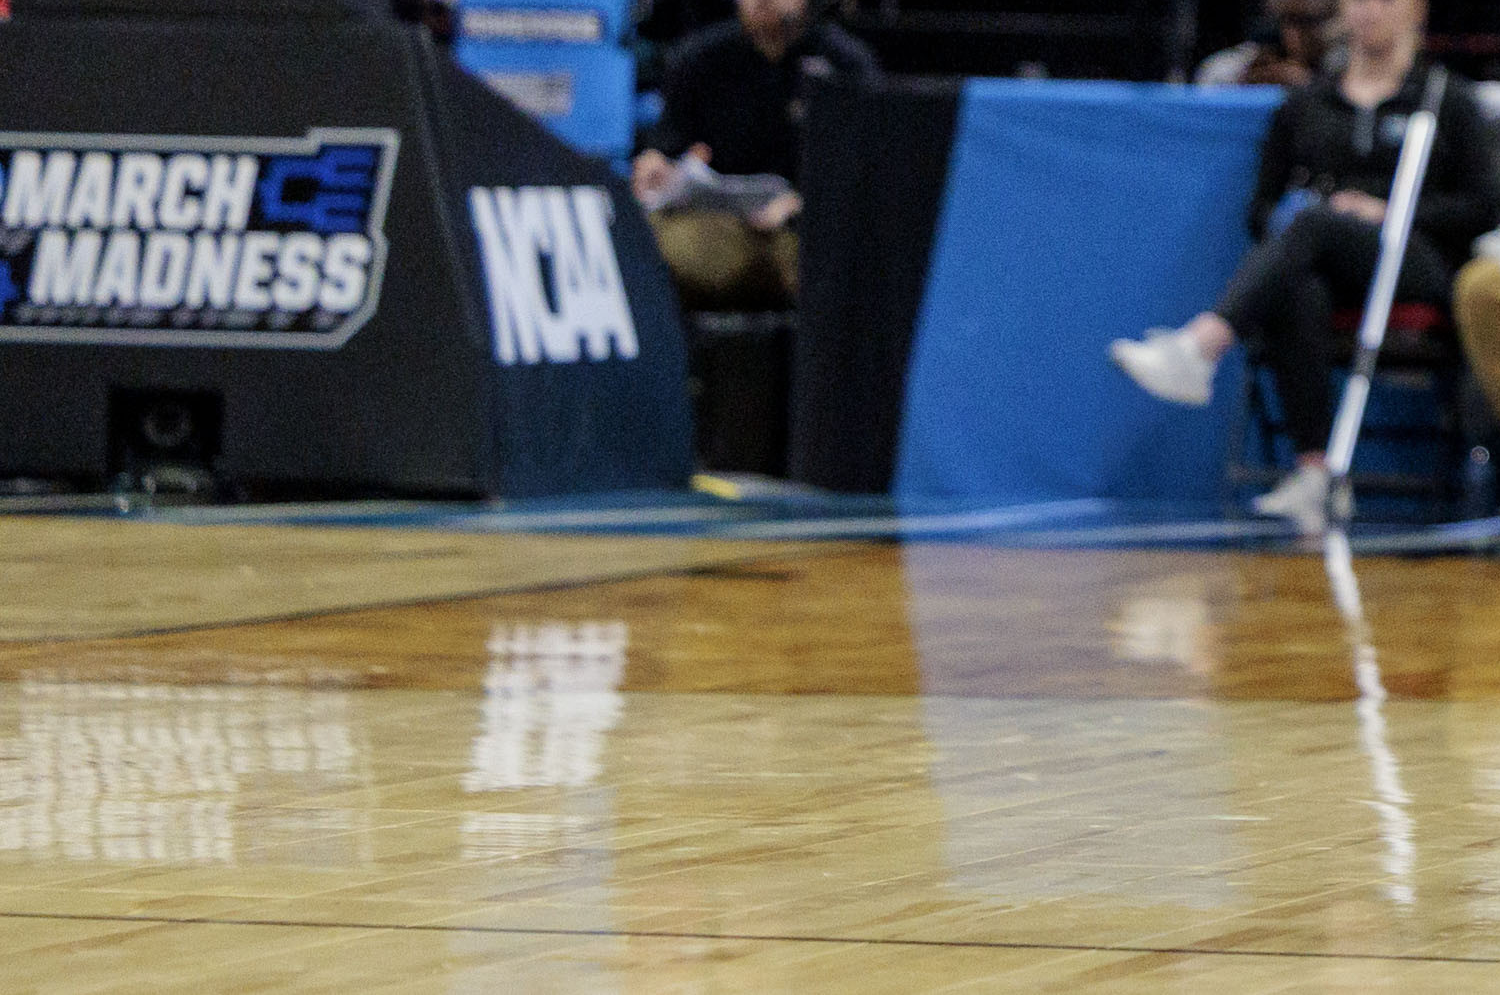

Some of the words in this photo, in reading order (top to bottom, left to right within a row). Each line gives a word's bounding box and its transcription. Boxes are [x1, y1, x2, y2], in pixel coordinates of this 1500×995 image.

[2, 150, 260, 231] MARCH
[28, 230, 372, 313] MADNESS
[468, 185, 640, 364] NCAA
